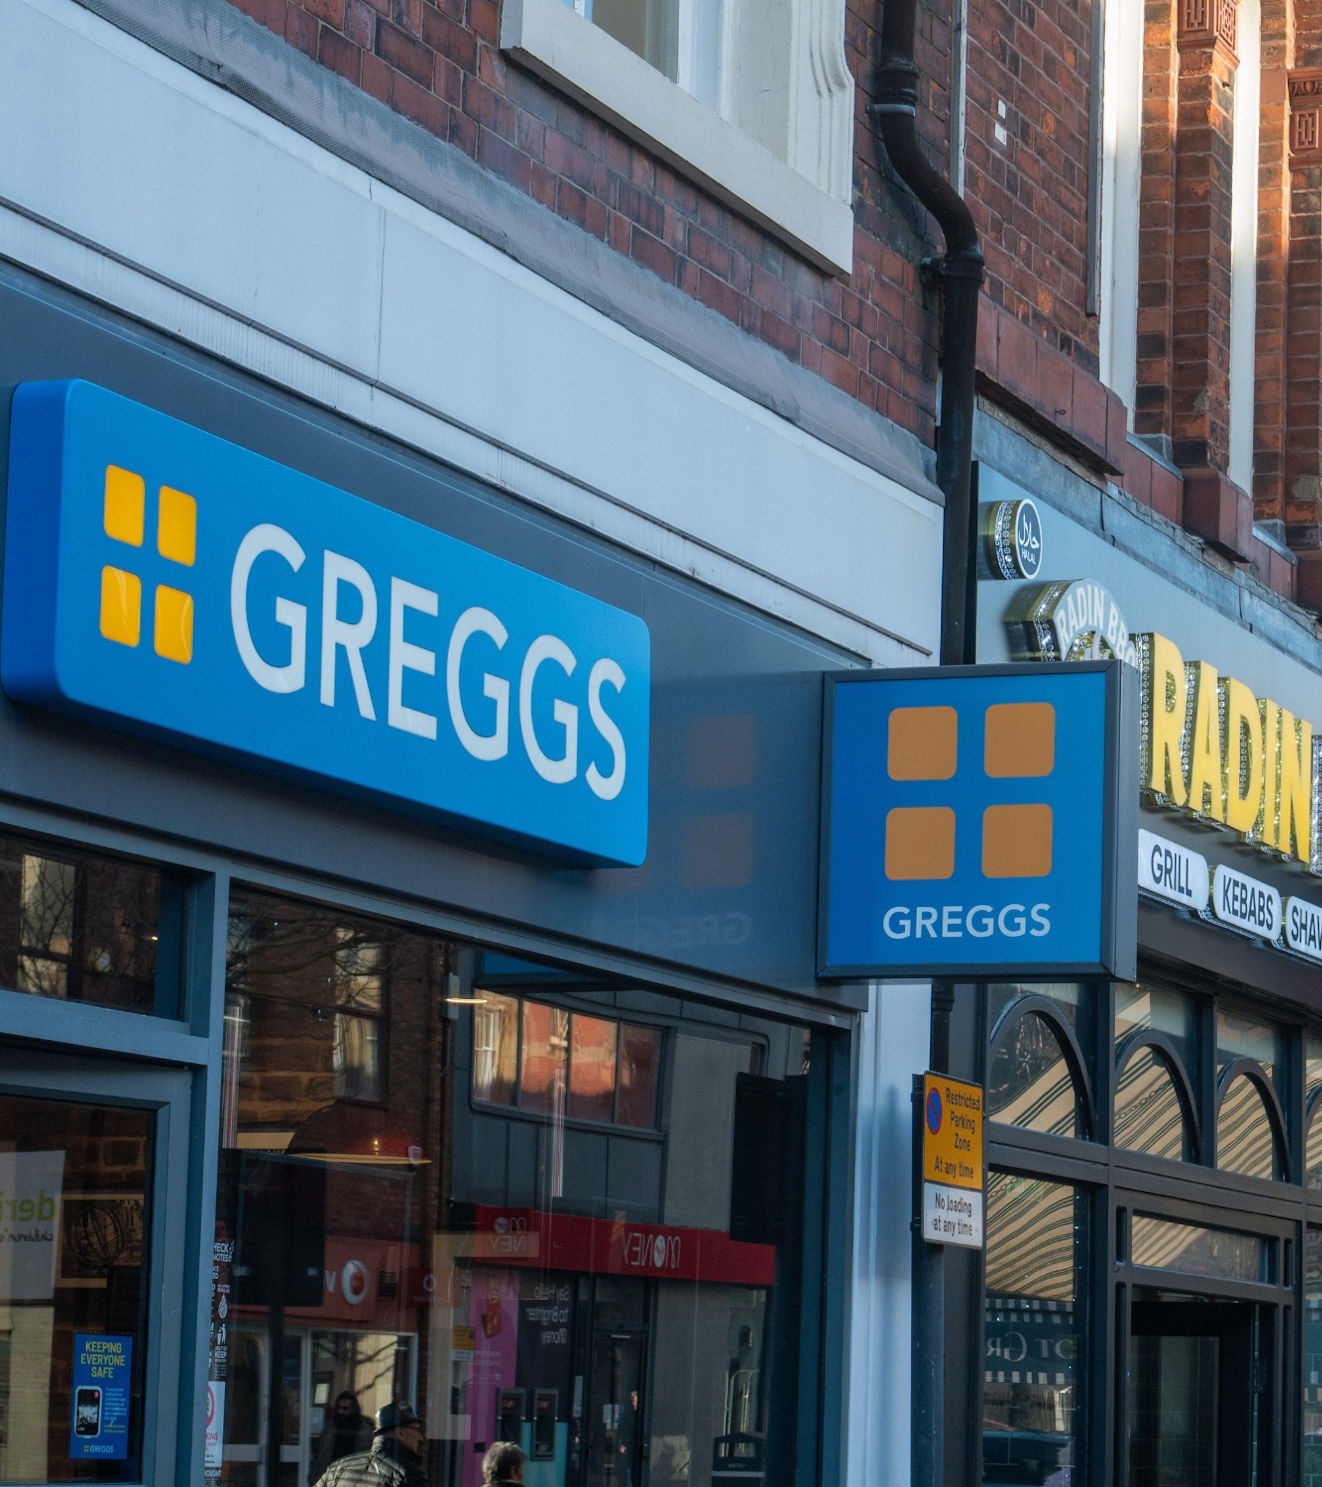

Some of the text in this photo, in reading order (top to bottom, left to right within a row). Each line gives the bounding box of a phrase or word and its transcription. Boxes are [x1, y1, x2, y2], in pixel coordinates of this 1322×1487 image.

[1021, 549, 1037, 565] HALAL
[1055, 584, 1136, 667] RADIN BBQ
[231, 523, 626, 801] GREGGS
[1151, 632, 1312, 865] RADIN
[1150, 844, 1193, 899] GRILL
[1221, 874, 1274, 932] KEBABS
[882, 902, 1051, 940] GREGGS
[945, 1087, 981, 1112] Restricted
[950, 1111, 976, 1134] Parking
[954, 1133, 971, 1151] Zone
[934, 1155, 974, 1179] At any time
[935, 1192, 946, 1210] No
[933, 1217, 973, 1237] at any time
[85, 1340, 122, 1353] KEEPING
[80, 1353, 126, 1367] EVERYONE
[90, 1366, 114, 1378] SAFE
